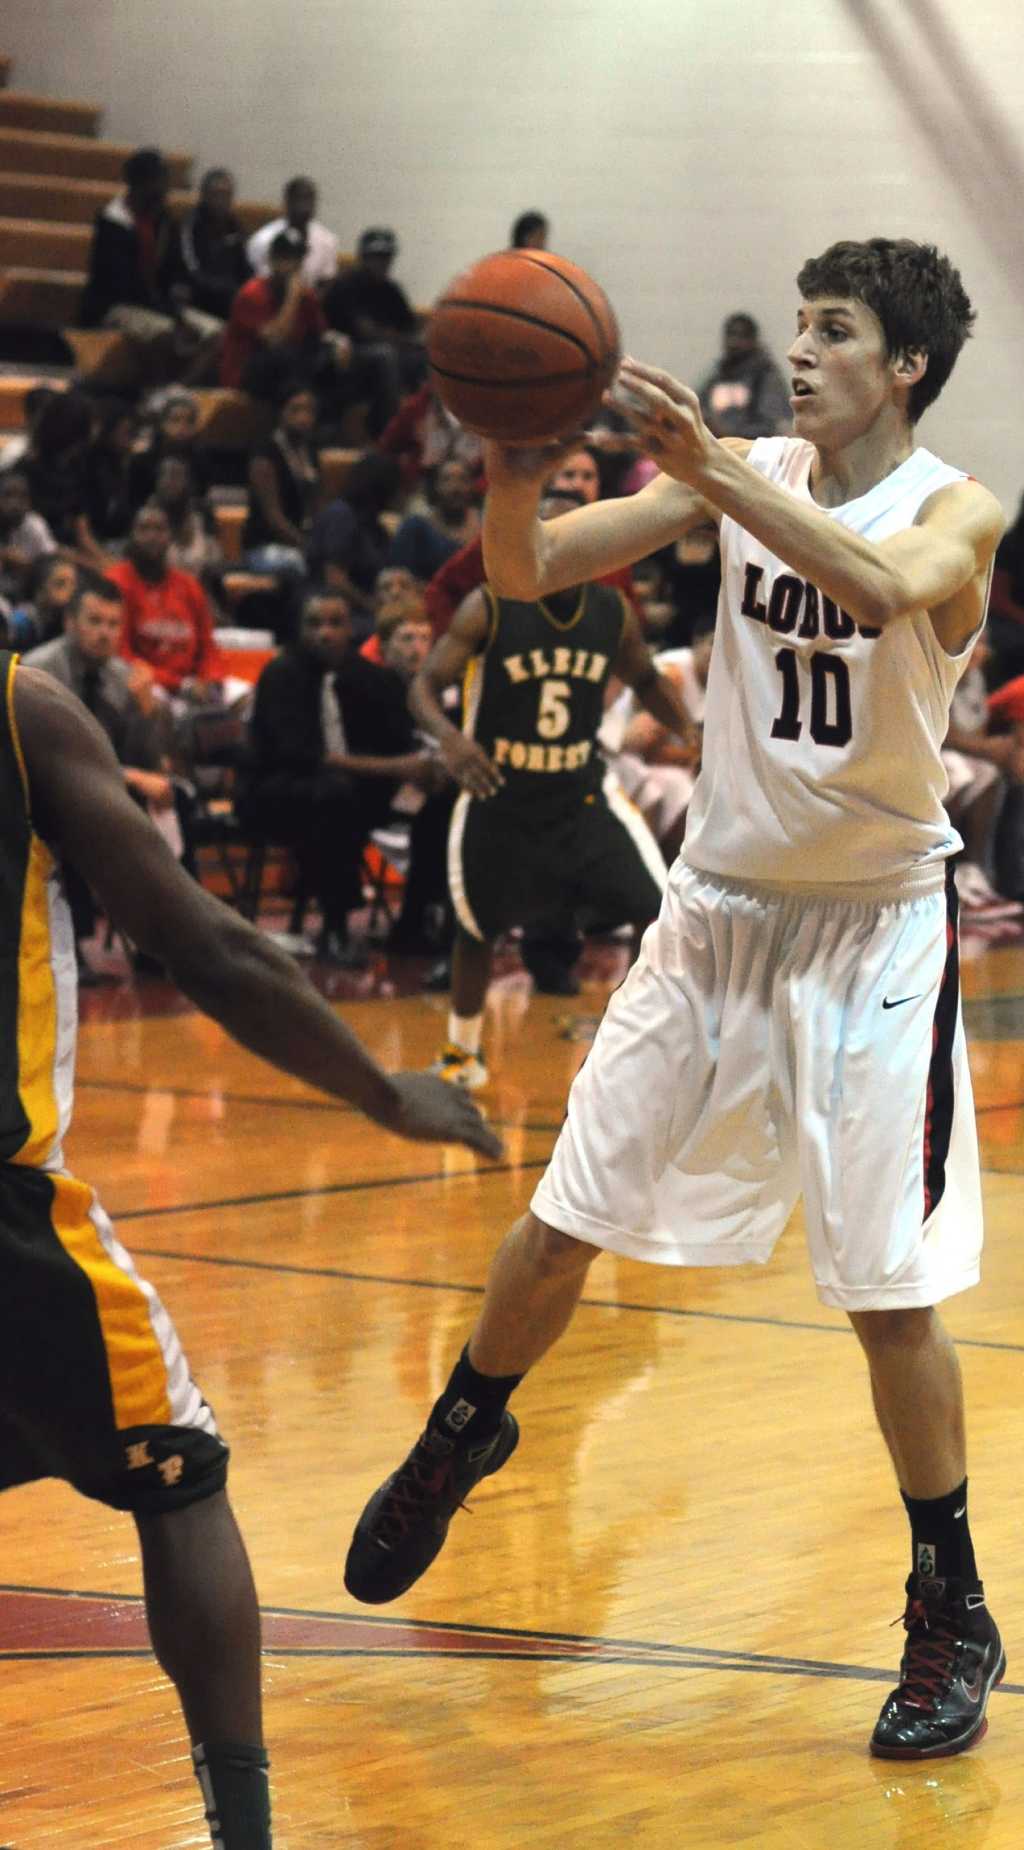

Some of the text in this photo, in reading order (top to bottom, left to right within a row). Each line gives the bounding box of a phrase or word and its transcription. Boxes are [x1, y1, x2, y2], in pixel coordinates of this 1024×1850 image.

[741, 562, 882, 639] LOBO
[503, 647, 608, 683] KLEIN
[770, 647, 853, 748] 10
[536, 679, 571, 740] 5
